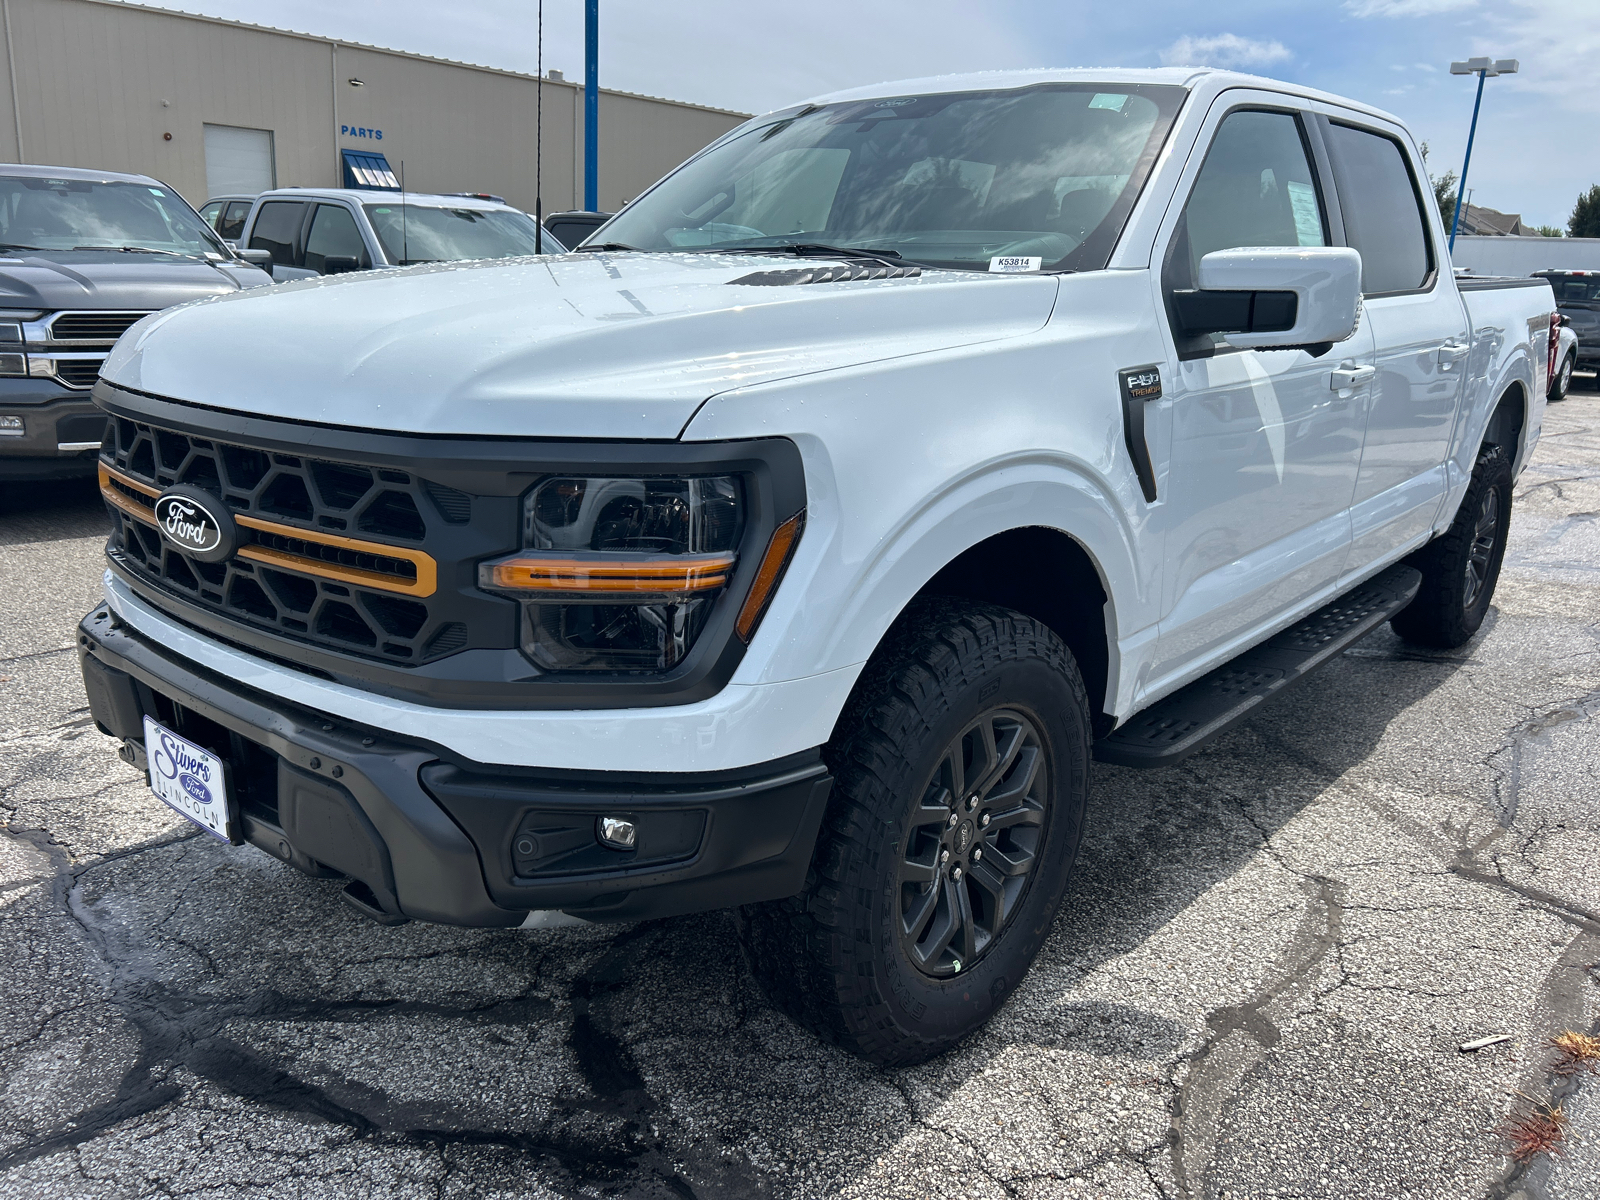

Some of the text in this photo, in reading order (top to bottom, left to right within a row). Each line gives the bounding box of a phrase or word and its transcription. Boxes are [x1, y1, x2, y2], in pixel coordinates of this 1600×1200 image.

[341, 125, 383, 140] PARTS
[998, 258, 1030, 267] K53814
[1130, 385, 1161, 397] TREMOR
[166, 501, 206, 545] Ford
[154, 733, 212, 783] Stivers
[163, 781, 219, 826] LINCOLN
[185, 776, 206, 800] Ford
[1059, 704, 1084, 866] GENERAL
[881, 871, 927, 1022] GRABBER
